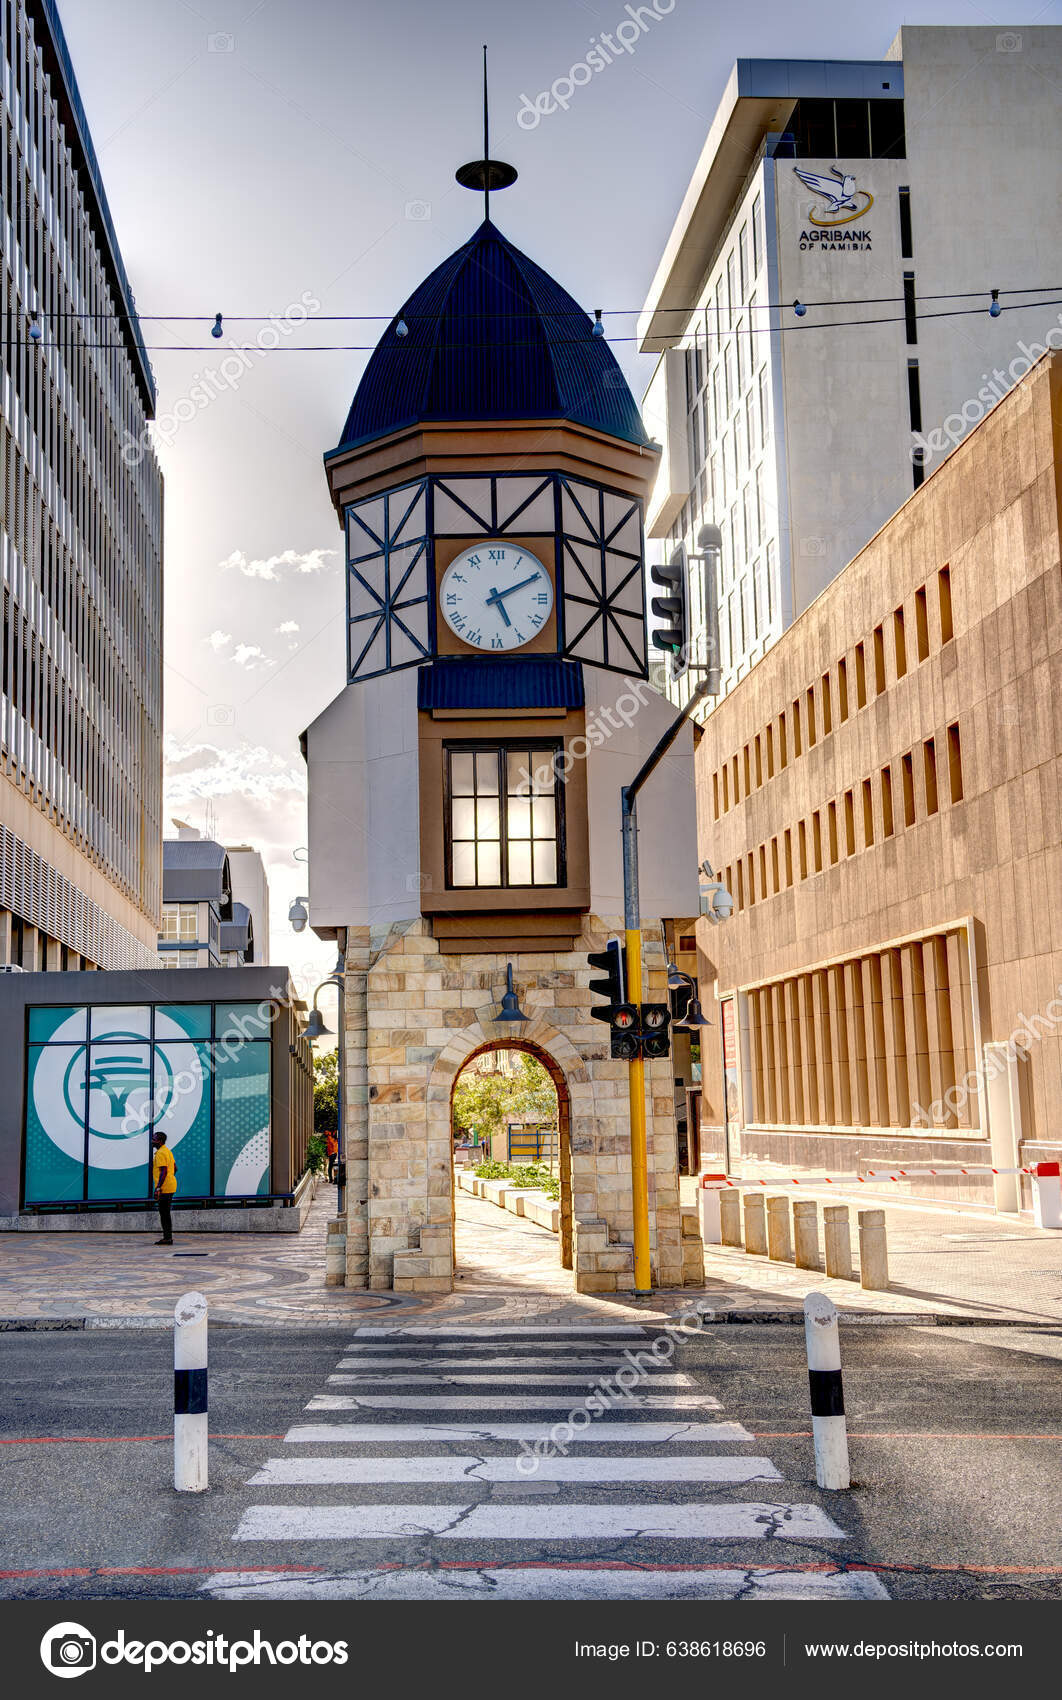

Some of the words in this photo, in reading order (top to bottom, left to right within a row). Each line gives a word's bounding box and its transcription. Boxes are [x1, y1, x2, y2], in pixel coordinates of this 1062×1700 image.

[799, 230, 872, 242] AGRIBANK
[799, 242, 815, 251] OF
[821, 242, 872, 251] NAMIBIA
[488, 550, 506, 560] XII
[467, 555, 482, 568] XI
[451, 572, 463, 582] X
[537, 593, 548, 605] III
